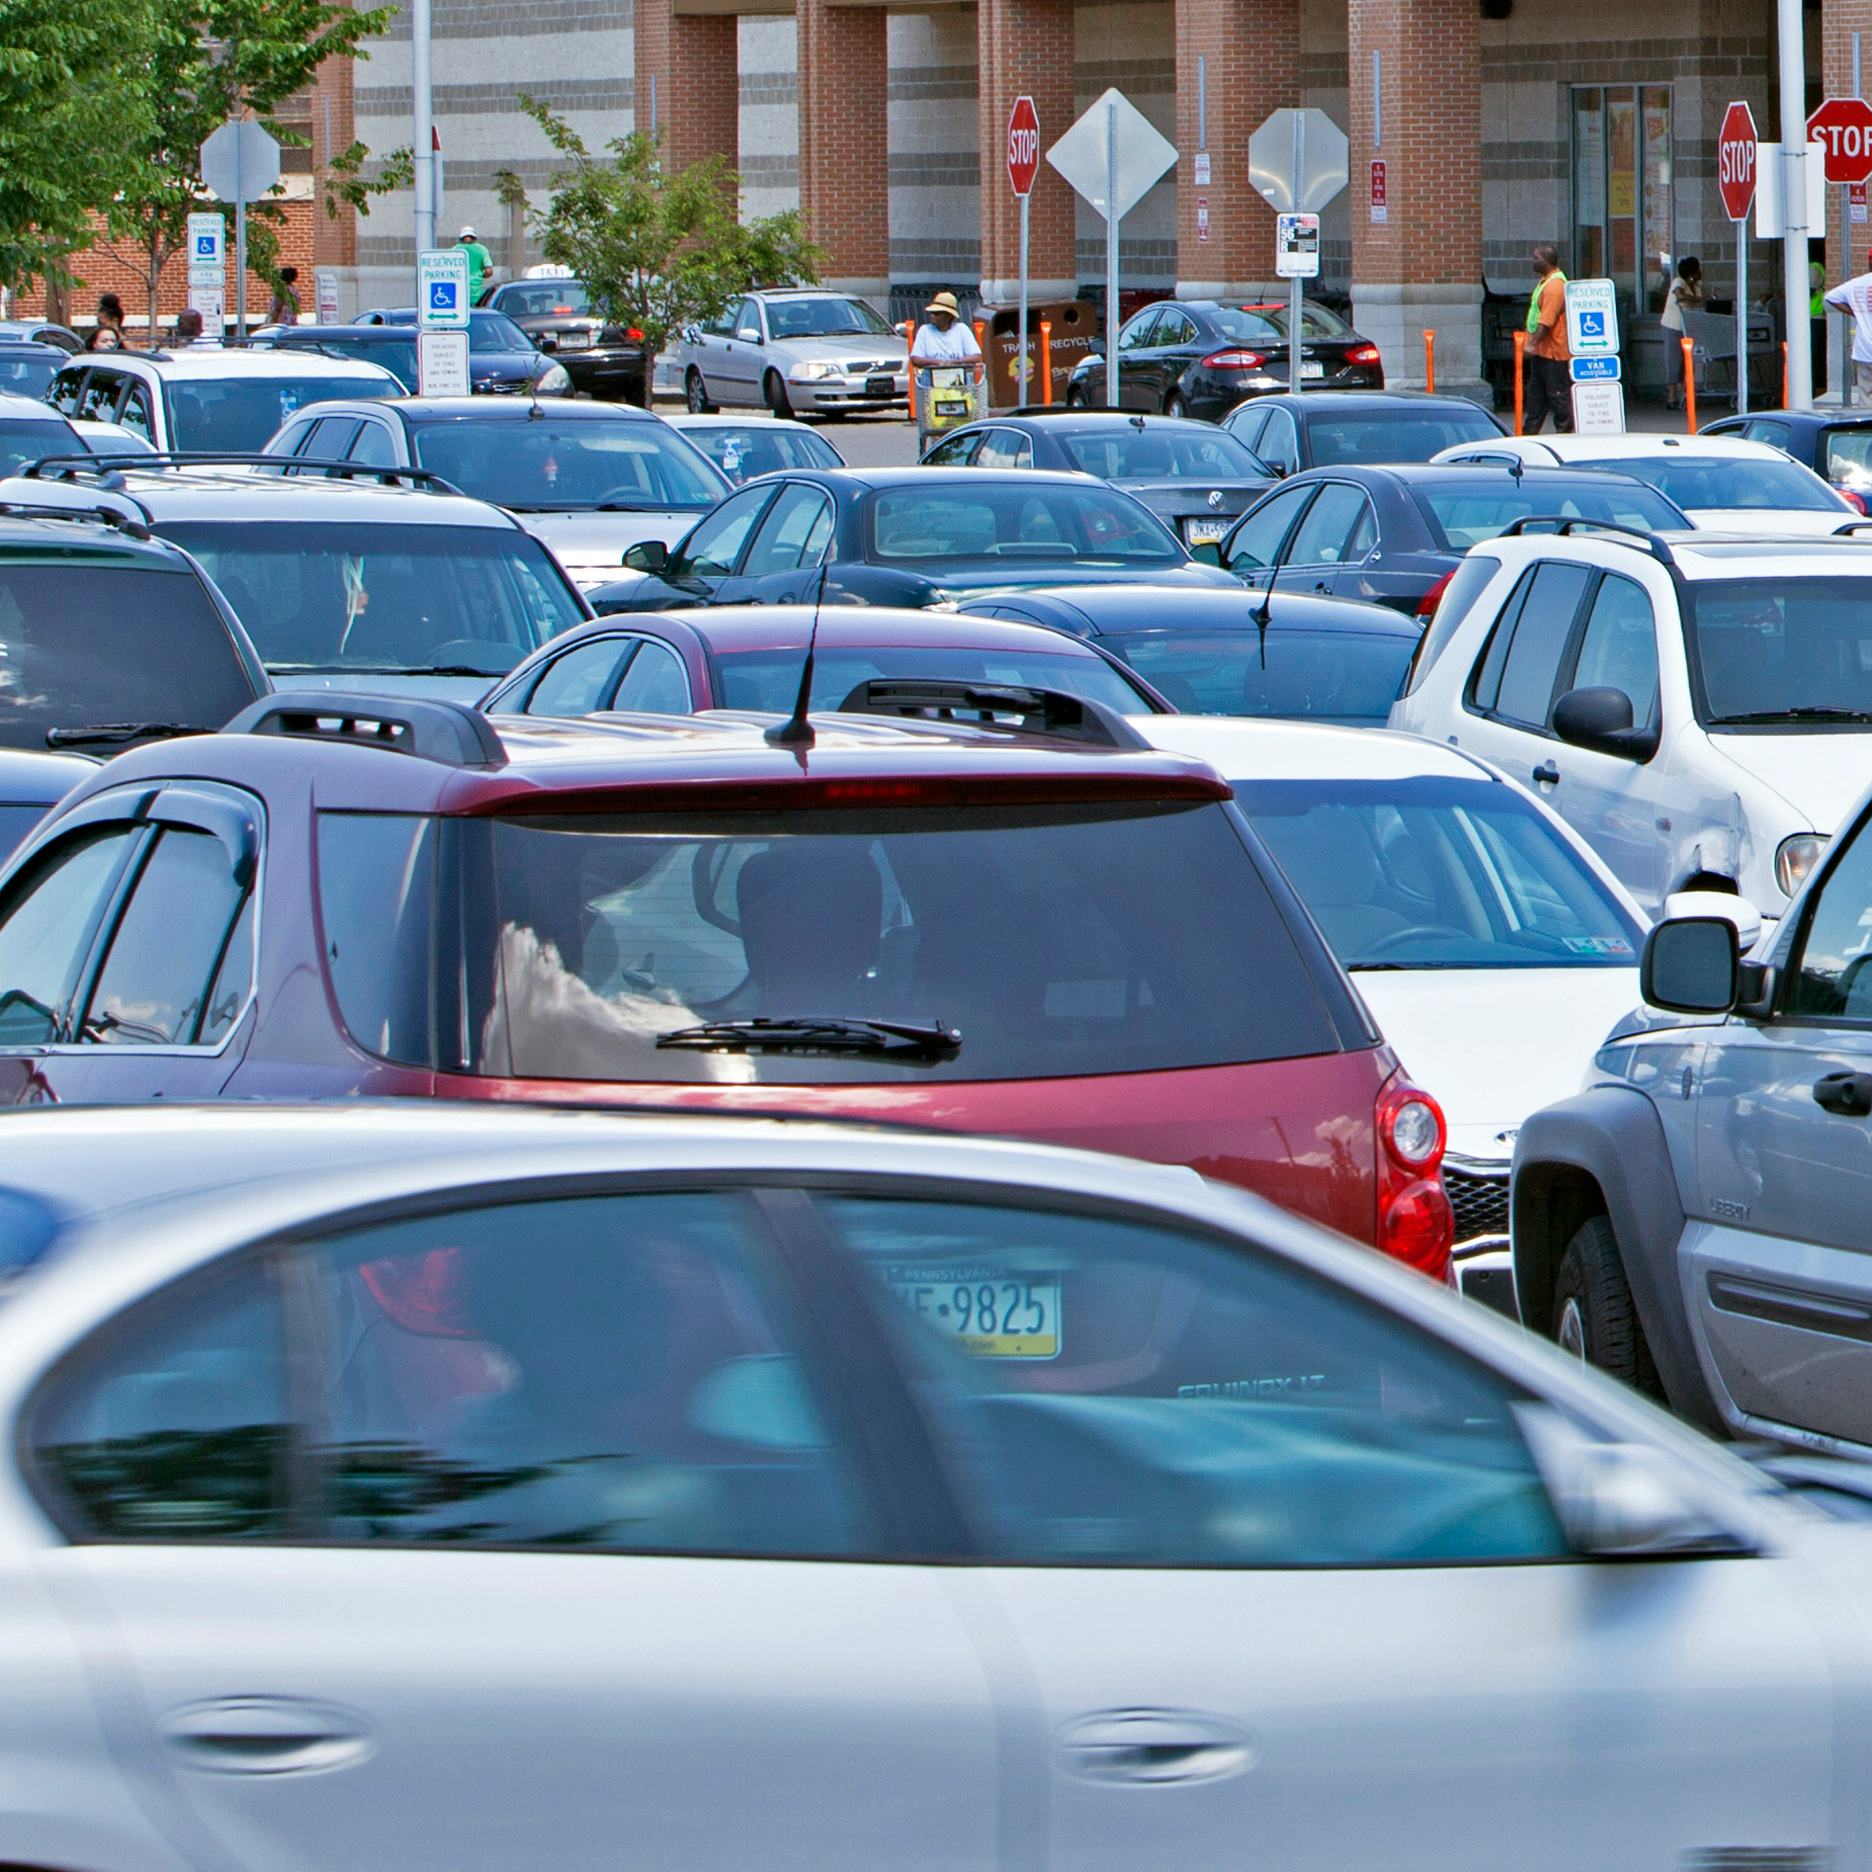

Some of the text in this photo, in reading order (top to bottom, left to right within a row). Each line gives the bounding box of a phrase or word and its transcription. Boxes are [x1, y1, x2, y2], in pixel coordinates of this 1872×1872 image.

[1009, 129, 1036, 164] STOP
[1722, 140, 1755, 183] STOP
[1280, 228, 1295, 240] 56
[421, 256, 465, 267] RESERVED
[424, 270, 462, 279] PARKING
[540, 268, 564, 276] TAXI
[1568, 287, 1611, 297] RESERVED
[1573, 300, 1609, 309] PARKING
[1587, 361, 1605, 369] VAN
